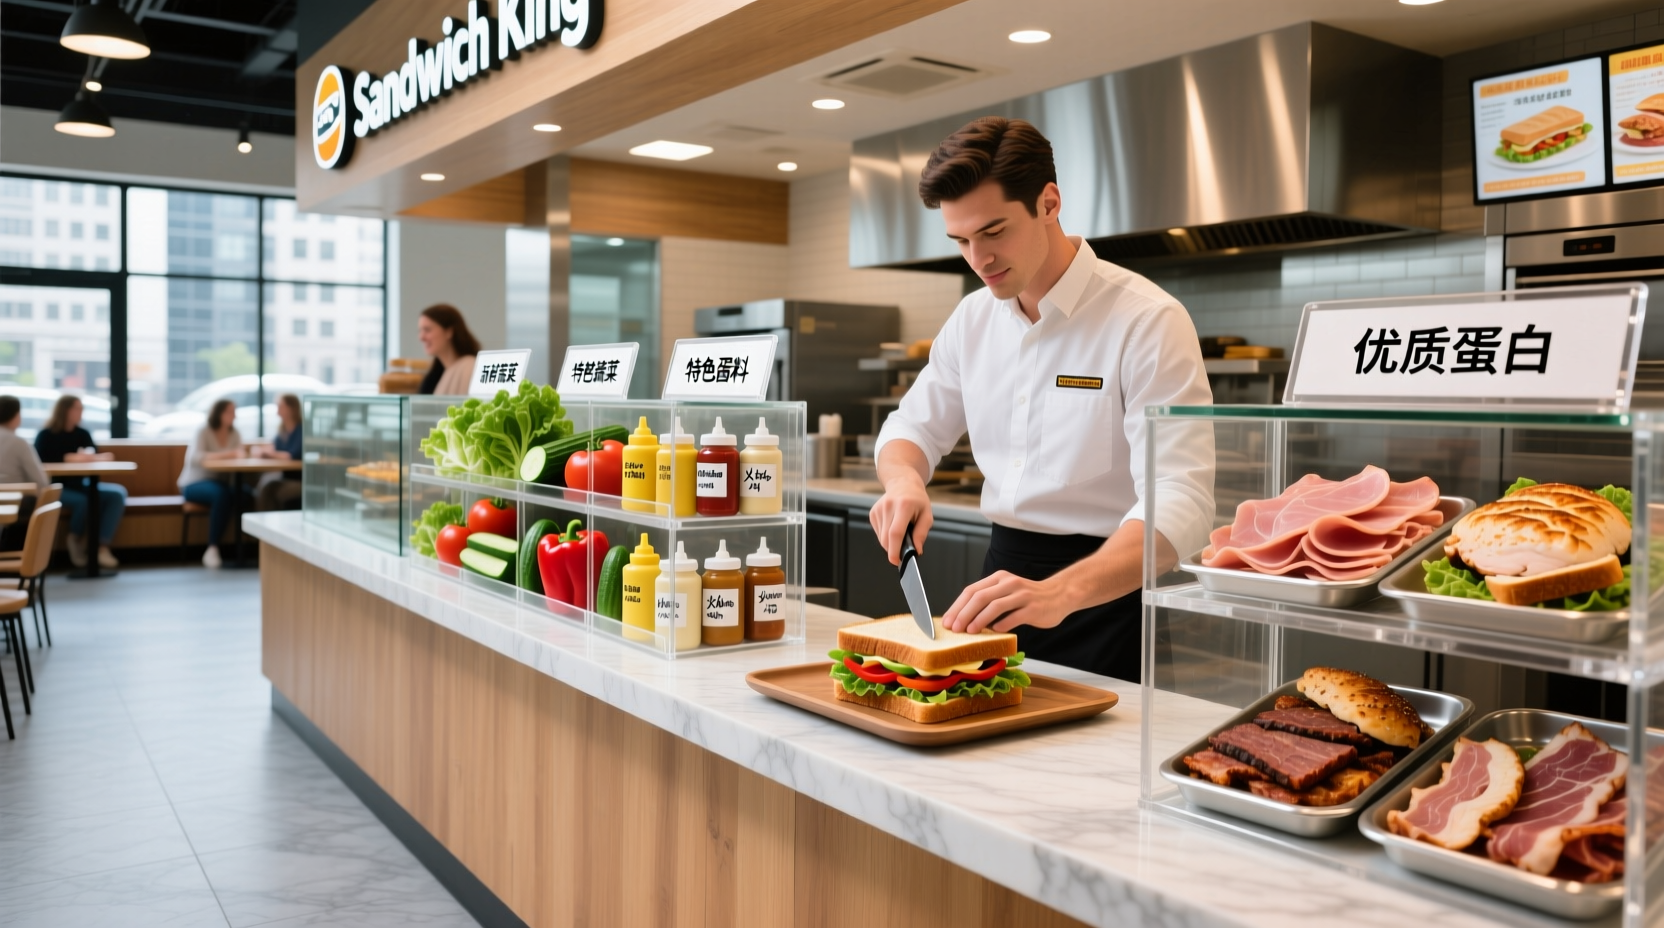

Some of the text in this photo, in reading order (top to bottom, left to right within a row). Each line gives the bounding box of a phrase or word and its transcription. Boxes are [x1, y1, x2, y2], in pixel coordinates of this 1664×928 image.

[353, 0, 590, 138] Sandwich King
[1353, 323, 1552, 375] 优质蛋白
